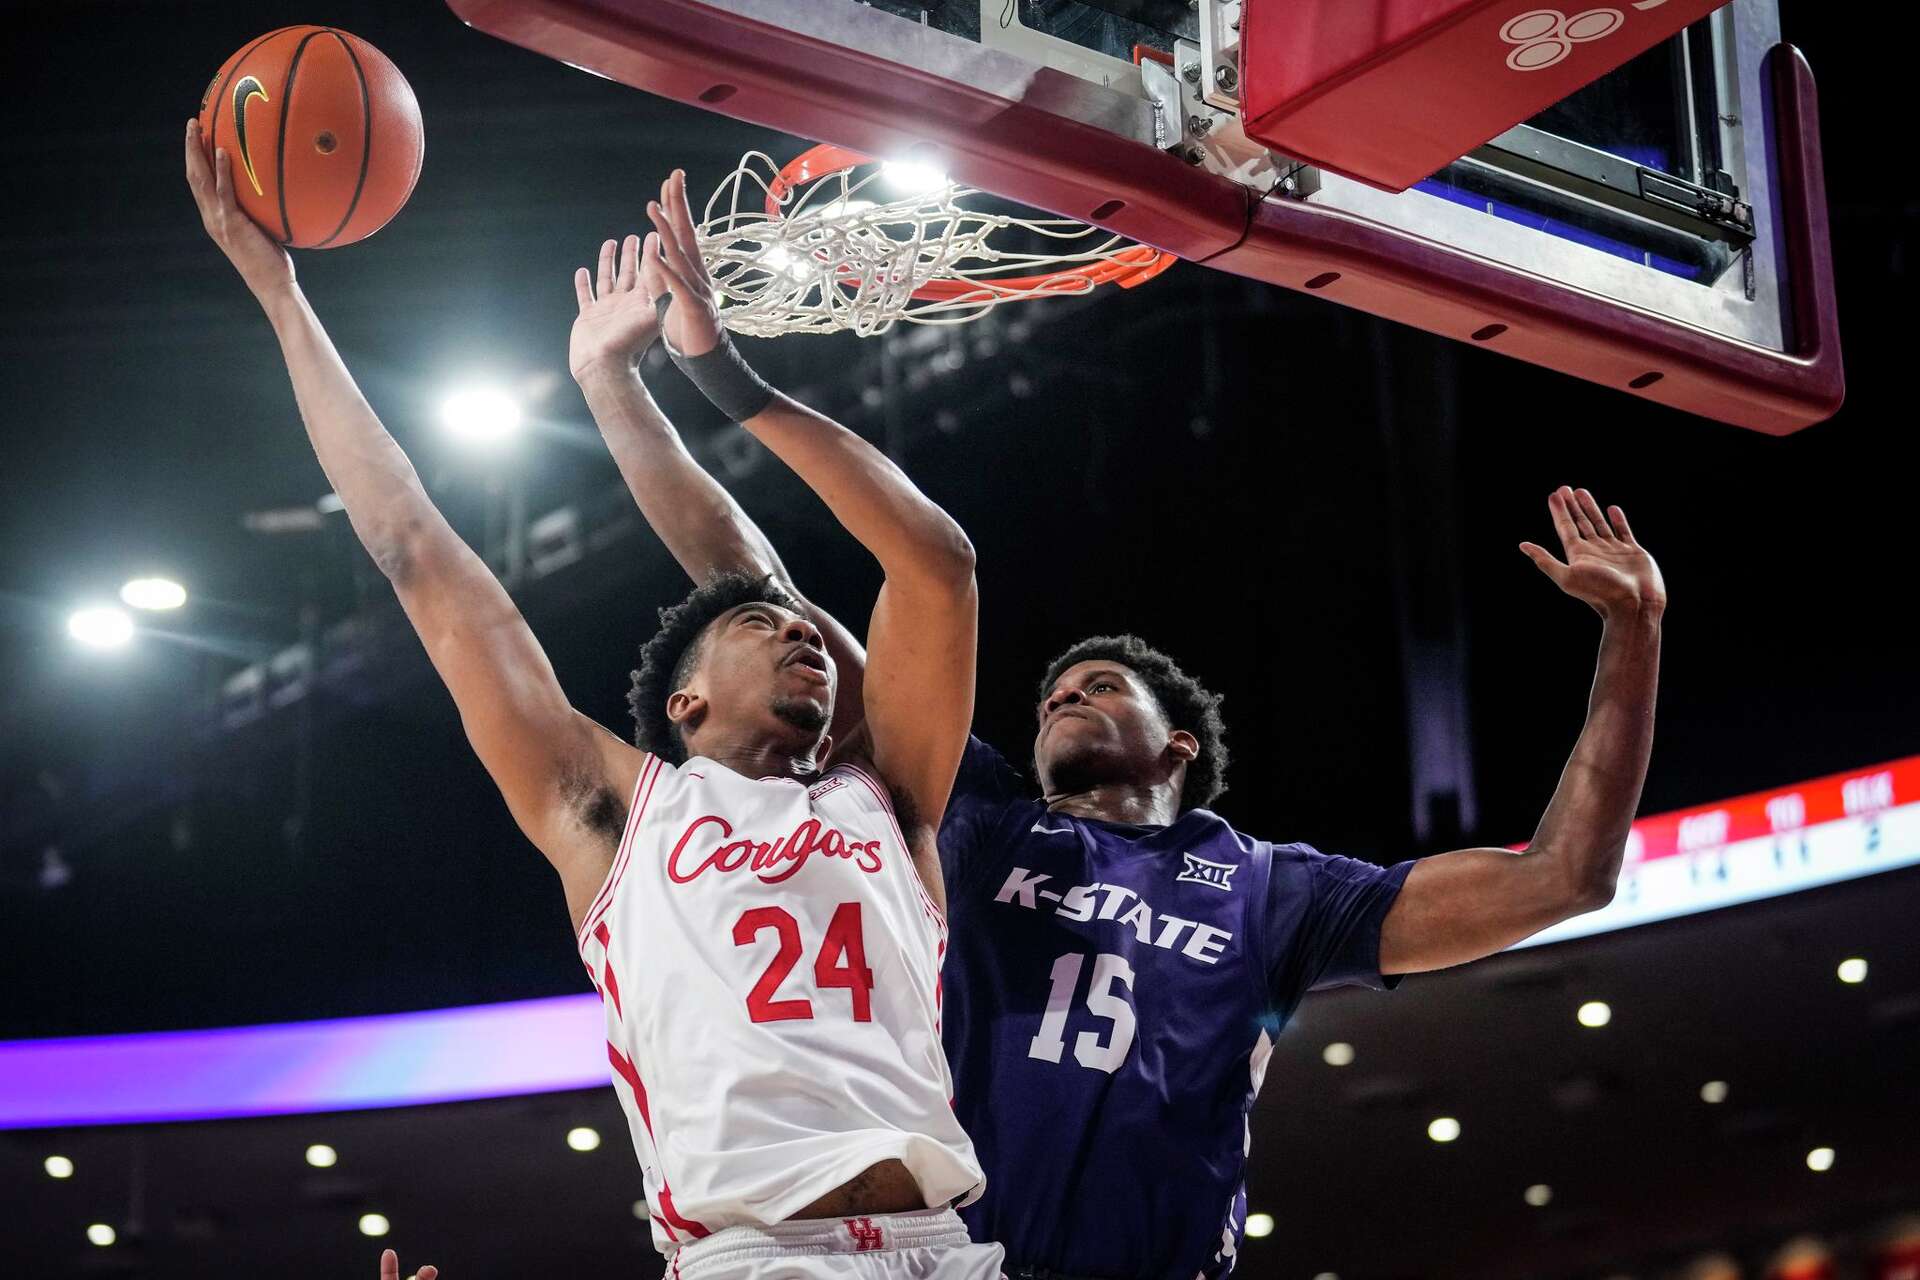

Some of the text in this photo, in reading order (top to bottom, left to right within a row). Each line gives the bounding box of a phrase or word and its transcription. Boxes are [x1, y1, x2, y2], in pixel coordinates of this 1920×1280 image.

[994, 866, 1233, 964] K-STATE
[1179, 855, 1235, 888] XII
[732, 902, 874, 1023] 24
[1028, 952, 1136, 1074] 15
[842, 1217, 884, 1251] UH
